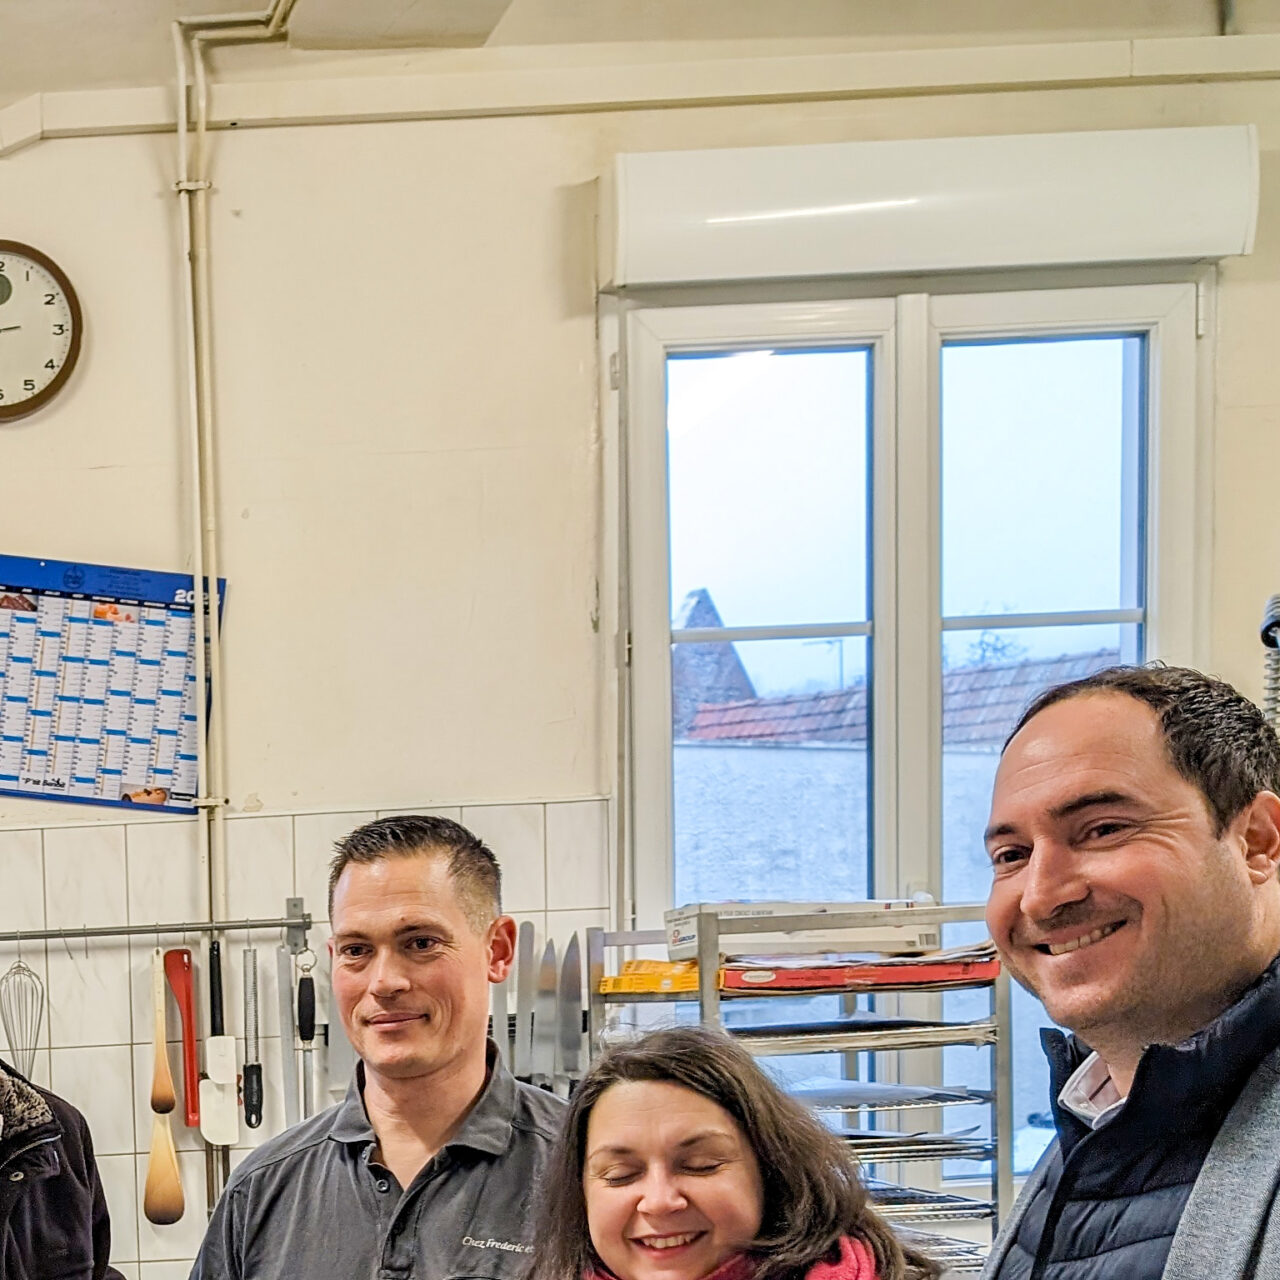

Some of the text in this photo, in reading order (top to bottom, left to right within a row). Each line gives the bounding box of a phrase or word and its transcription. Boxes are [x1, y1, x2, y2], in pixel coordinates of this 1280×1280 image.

[44, 294, 55, 305] 2
[52, 324, 65, 336] 3
[44, 359, 55, 370] 4
[24, 380, 36, 391] 5
[486, 1238, 525, 1253] Frederic
